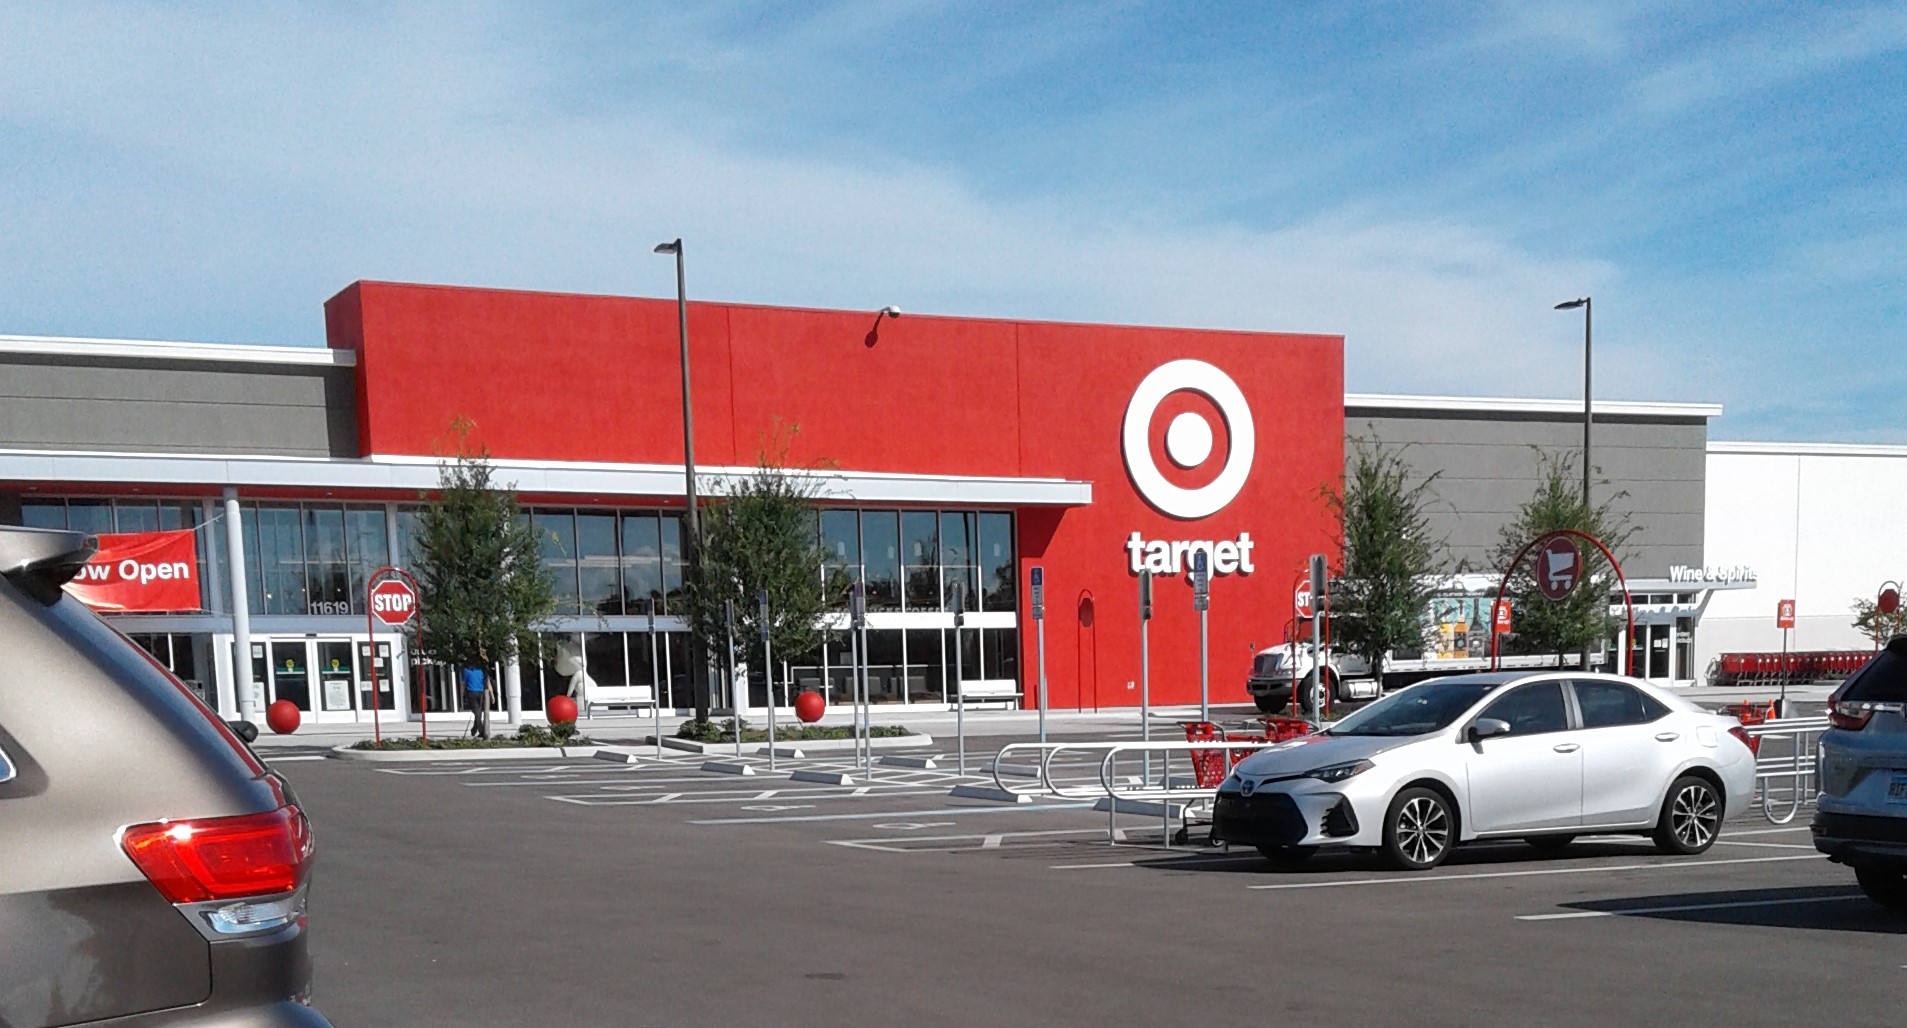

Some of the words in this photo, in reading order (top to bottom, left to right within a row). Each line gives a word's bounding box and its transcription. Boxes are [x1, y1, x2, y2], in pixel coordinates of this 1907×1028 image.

[1127, 531, 1255, 582] target
[118, 559, 189, 585] Open
[1669, 565, 1703, 581] Wine
[1718, 565, 1758, 584] Spirits
[310, 601, 349, 615] 11619
[374, 593, 412, 612] STOP
